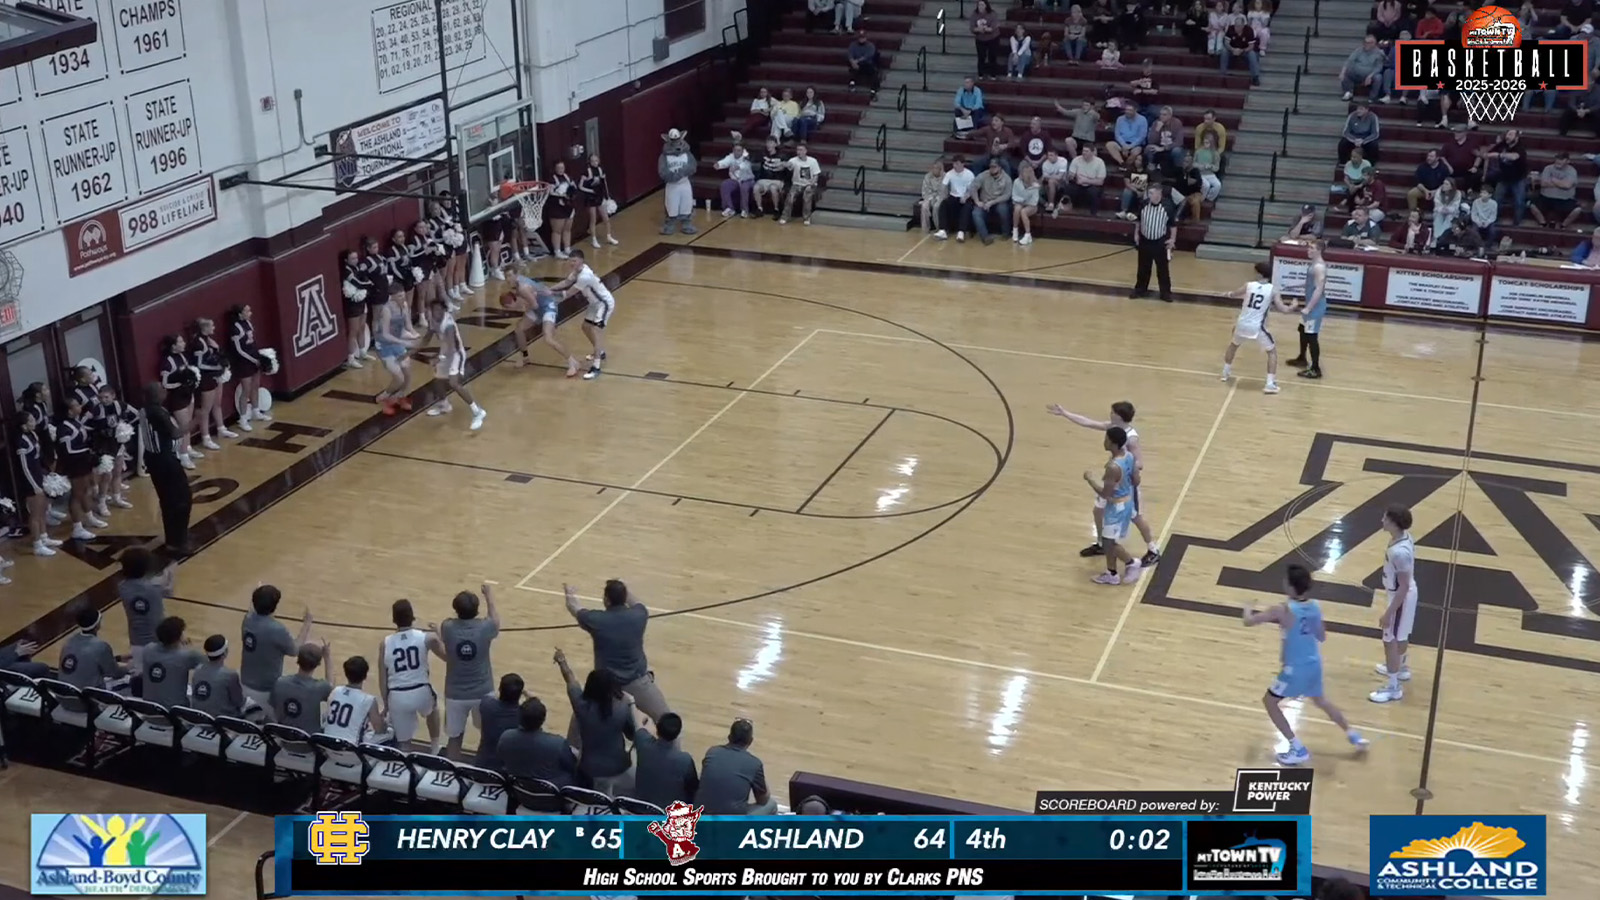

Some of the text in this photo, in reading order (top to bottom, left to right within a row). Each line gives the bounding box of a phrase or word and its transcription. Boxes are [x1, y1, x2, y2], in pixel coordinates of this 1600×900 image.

[119, 0, 176, 28] CHAMPS
[390, 0, 432, 20] REGIONAL
[133, 28, 169, 54] 1961
[48, 48, 90, 76] 1934
[145, 95, 177, 121] STATE
[64, 118, 99, 146] STATE
[135, 117, 192, 151] RUNNER-UP
[357, 116, 401, 137] WELCOME TO
[360, 127, 401, 151] THE ASHLAND
[53, 141, 116, 178] RUNNER-UP
[150, 147, 187, 175] 1996
[71, 172, 112, 202] 1962
[128, 200, 205, 239] 988 LIFELINE
[1421, 272, 1474, 281] SCHOLARSHIPS
[1498, 279, 1585, 291] TOMCAT SCHOLARSHIPS
[1247, 292, 1264, 310] 12
[293, 274, 338, 357] A
[392, 645, 420, 673] 20
[327, 700, 354, 728] 30
